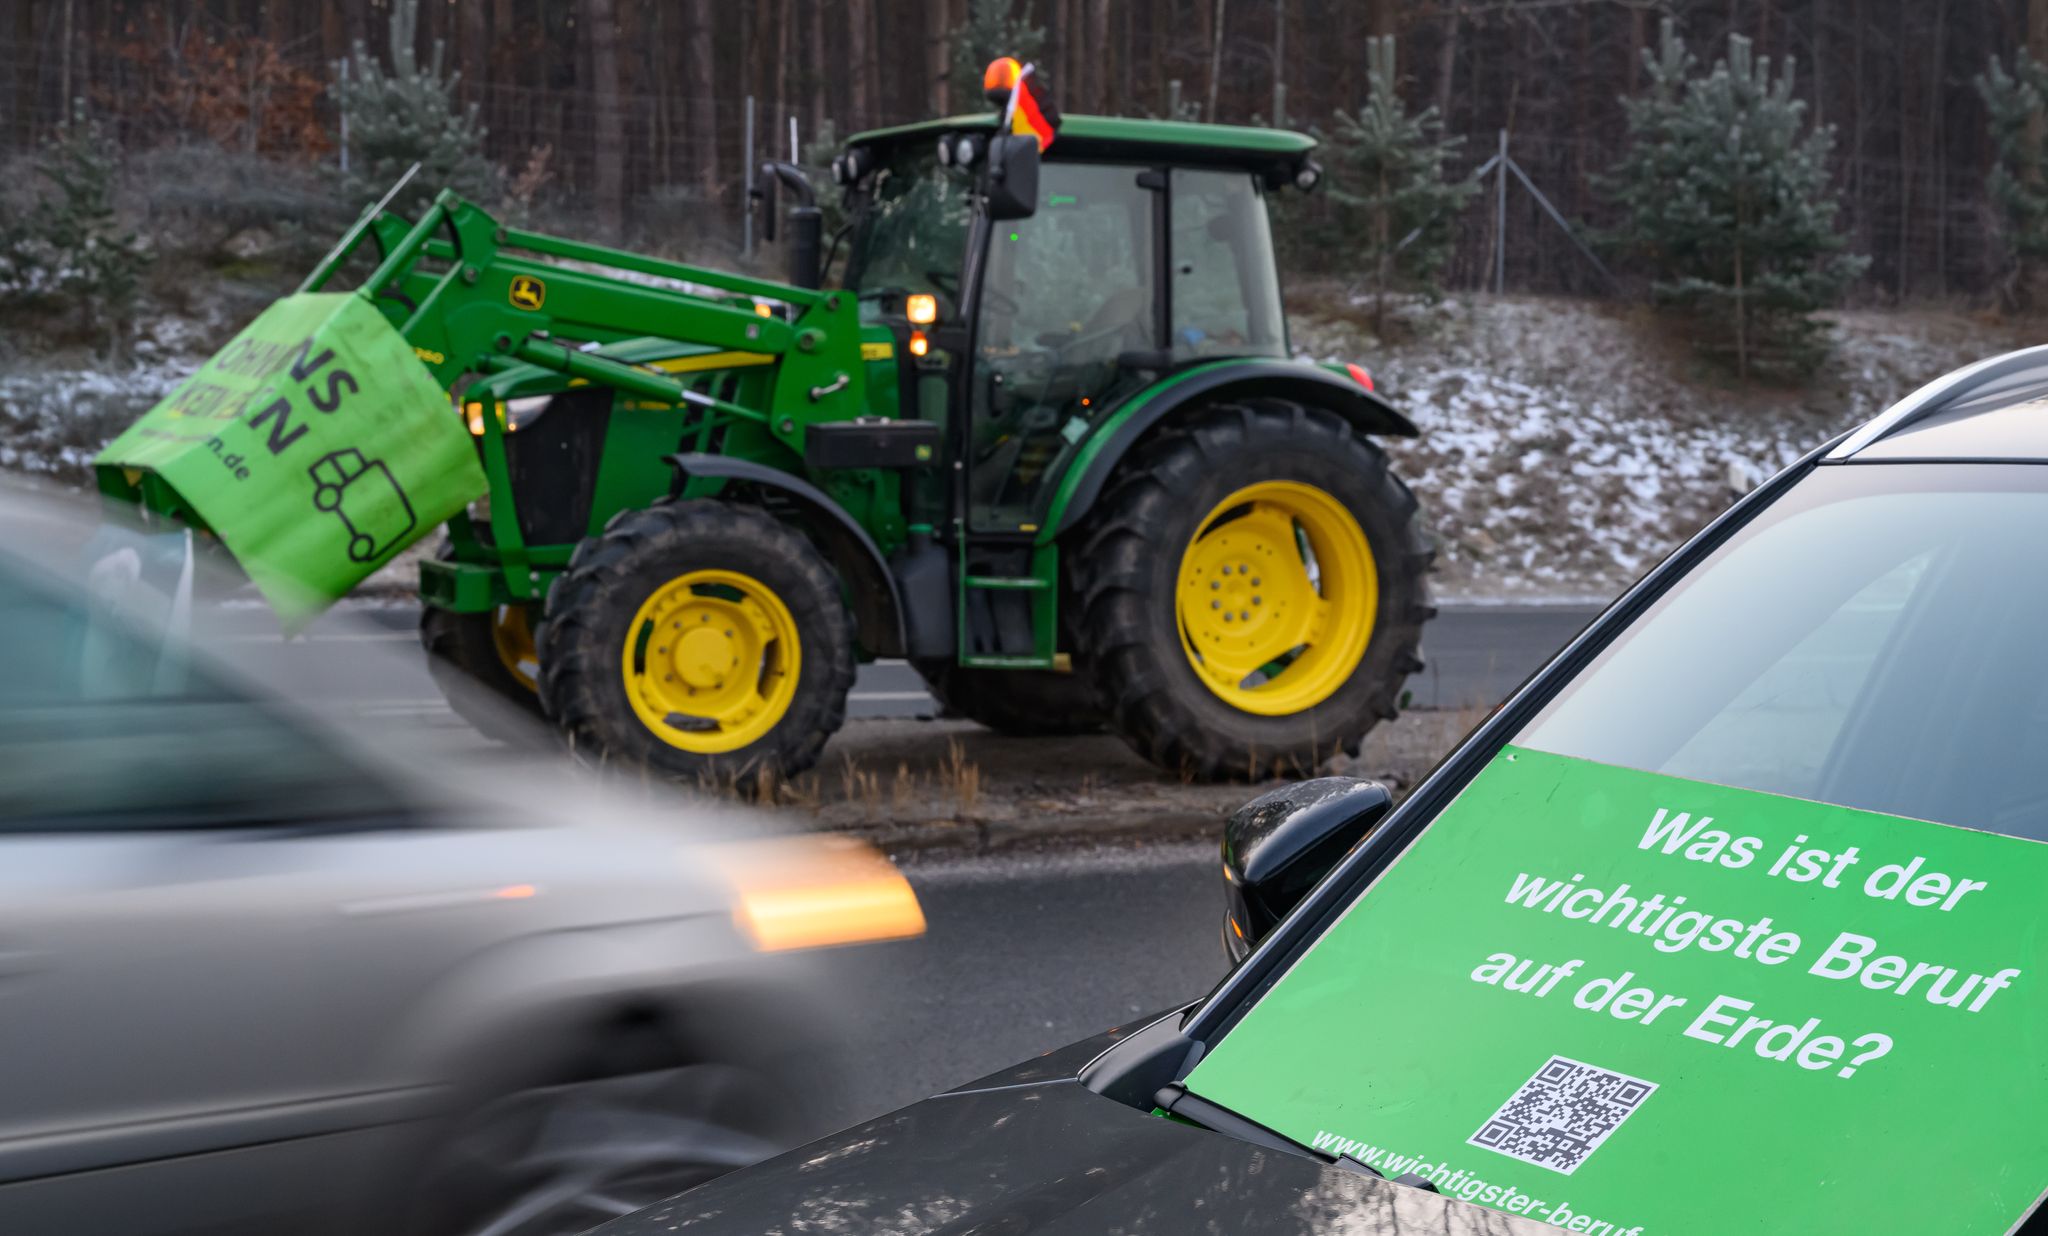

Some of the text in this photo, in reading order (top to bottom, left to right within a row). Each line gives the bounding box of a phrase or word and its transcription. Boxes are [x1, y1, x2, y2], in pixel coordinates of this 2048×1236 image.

[1637, 807, 1988, 912] Was ist der
[1503, 872, 2021, 1013] wichtigste Beruf
[1470, 951, 1894, 1079] auf der Erde?
